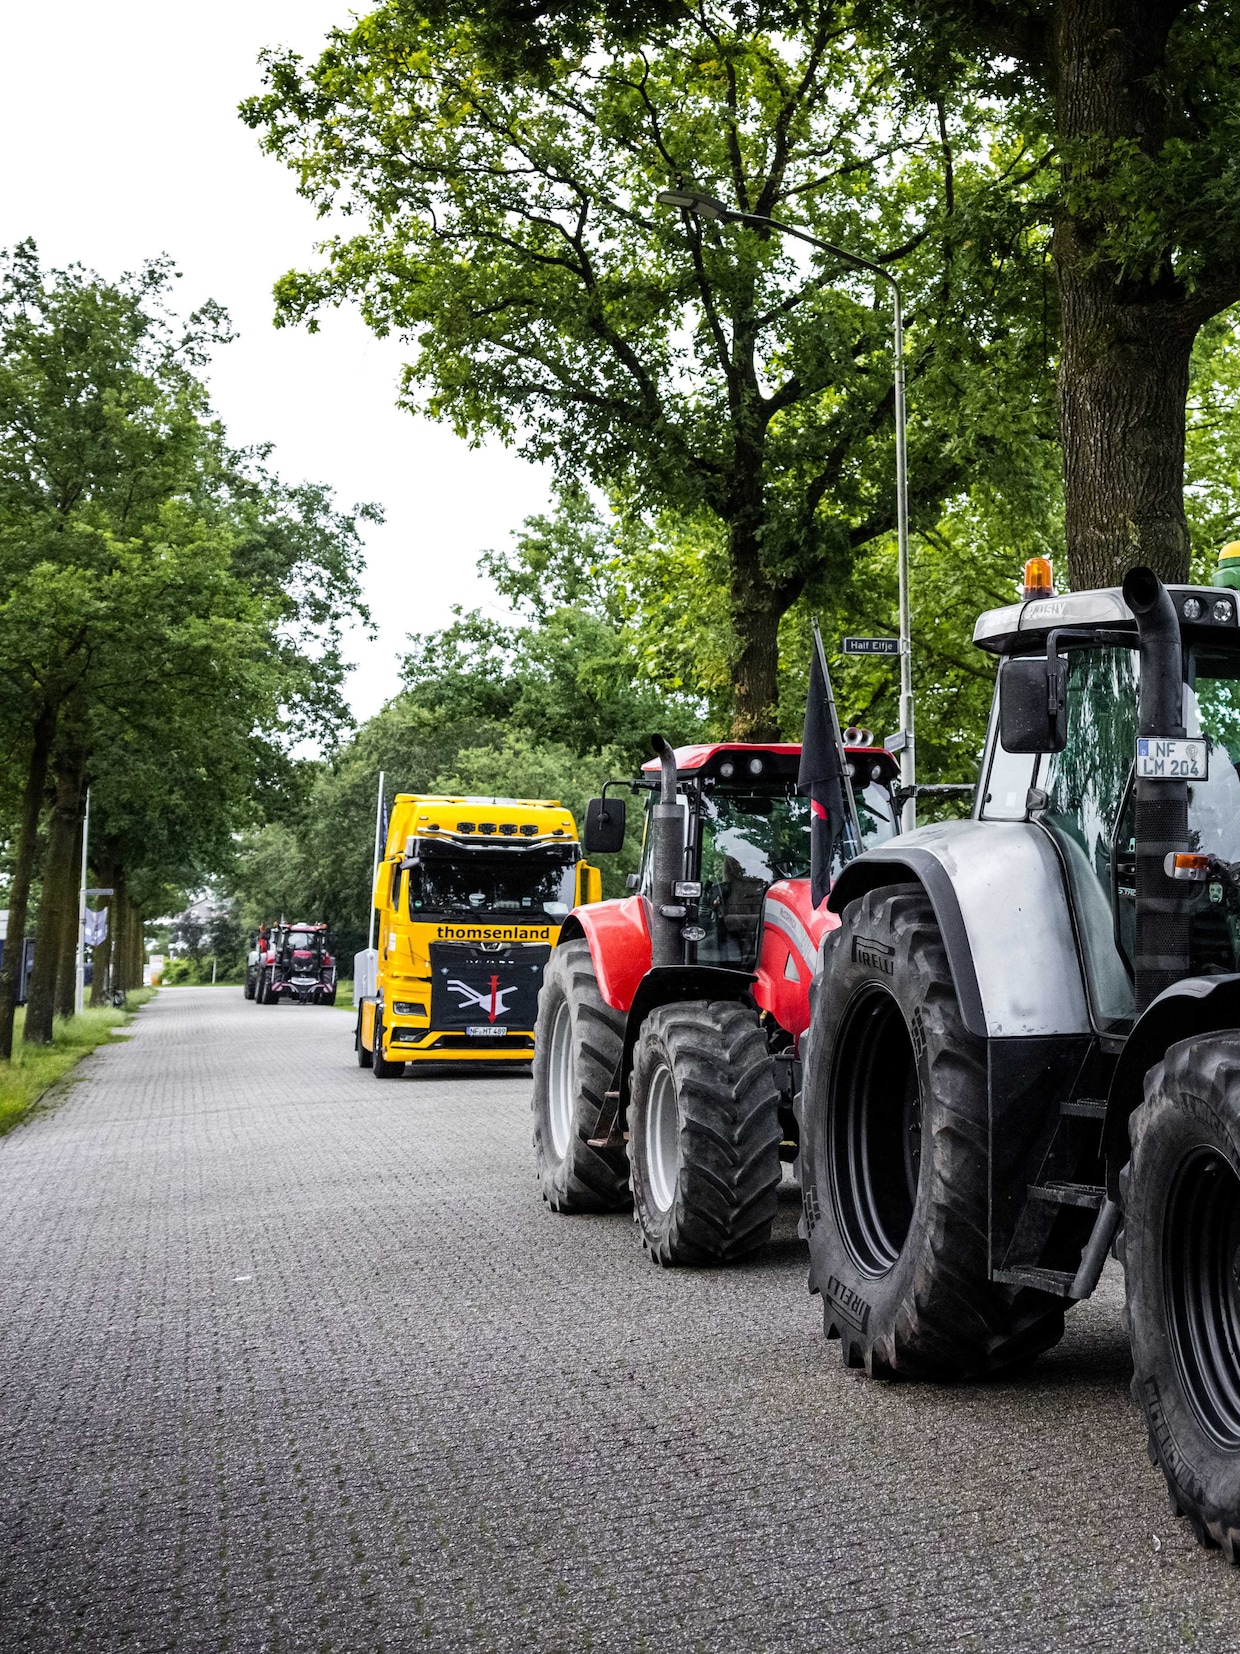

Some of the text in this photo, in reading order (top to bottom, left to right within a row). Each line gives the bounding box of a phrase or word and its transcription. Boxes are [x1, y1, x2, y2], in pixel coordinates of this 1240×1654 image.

[850, 641, 893, 652] Half Elfje
[1156, 742, 1176, 757] NF
[1144, 759, 1199, 776] LM 204
[437, 926, 550, 939] thomsenland
[852, 935, 895, 976] PIRELLI
[826, 1275, 872, 1335] PIRELLI
